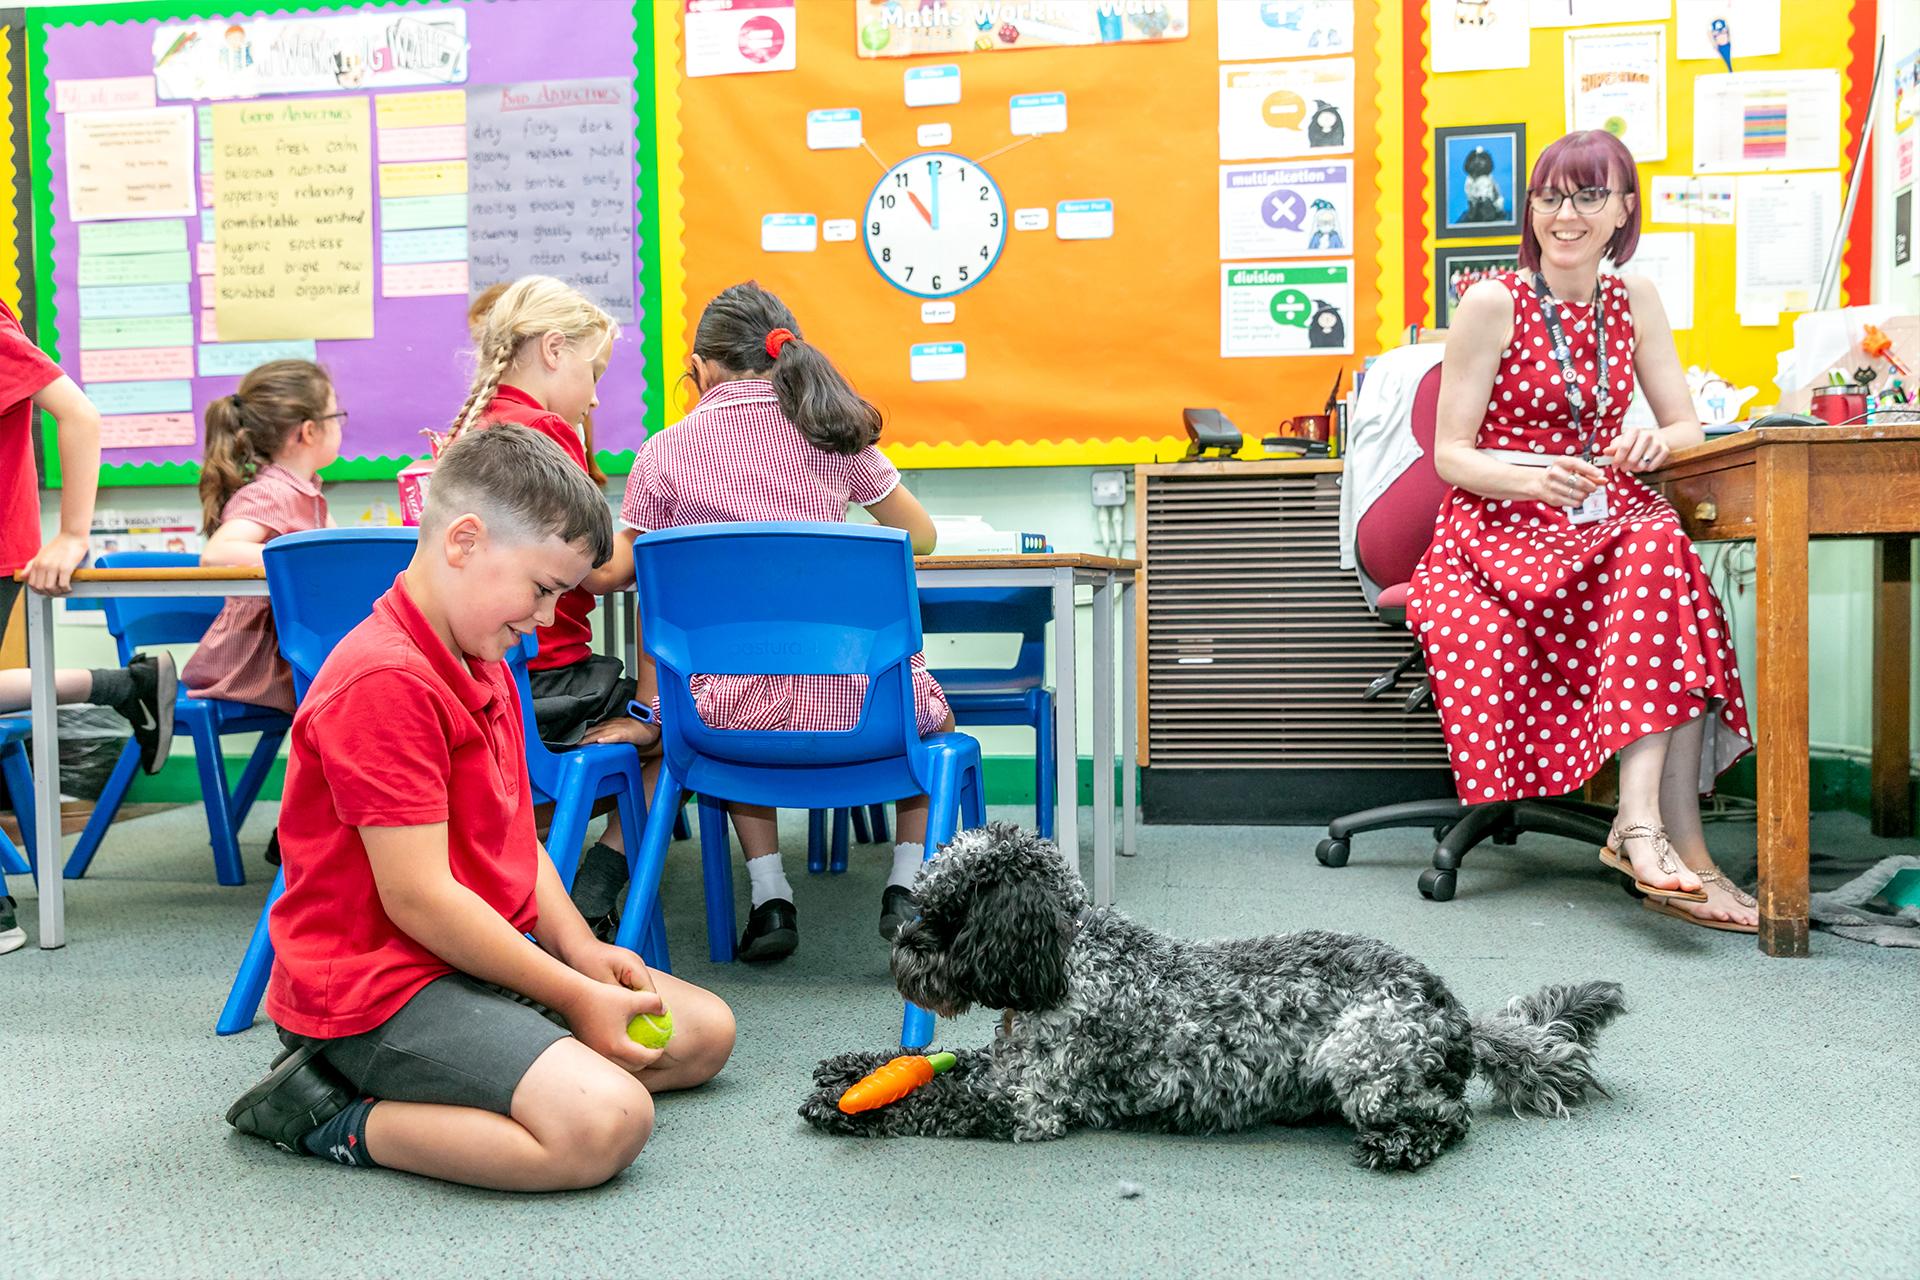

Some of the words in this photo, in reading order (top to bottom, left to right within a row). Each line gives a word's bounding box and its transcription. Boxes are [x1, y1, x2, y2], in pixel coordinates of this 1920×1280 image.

[880, 1, 963, 29] Maths
[926, 160, 942, 175] 12
[958, 167, 965, 182] 1
[895, 172, 909, 188] 11
[1232, 169, 1325, 188] multiplication
[295, 183, 355, 201] relaxing
[979, 186, 989, 201] 2
[879, 194, 896, 209] 10
[222, 213, 299, 230] comfortable
[989, 212, 999, 228] 3
[871, 221, 881, 236] 9
[882, 247, 891, 262] 8
[979, 245, 989, 261] 4
[904, 266, 914, 282] 7
[958, 265, 969, 281] 5
[1233, 270, 1285, 284] division
[932, 275, 942, 290] 6
